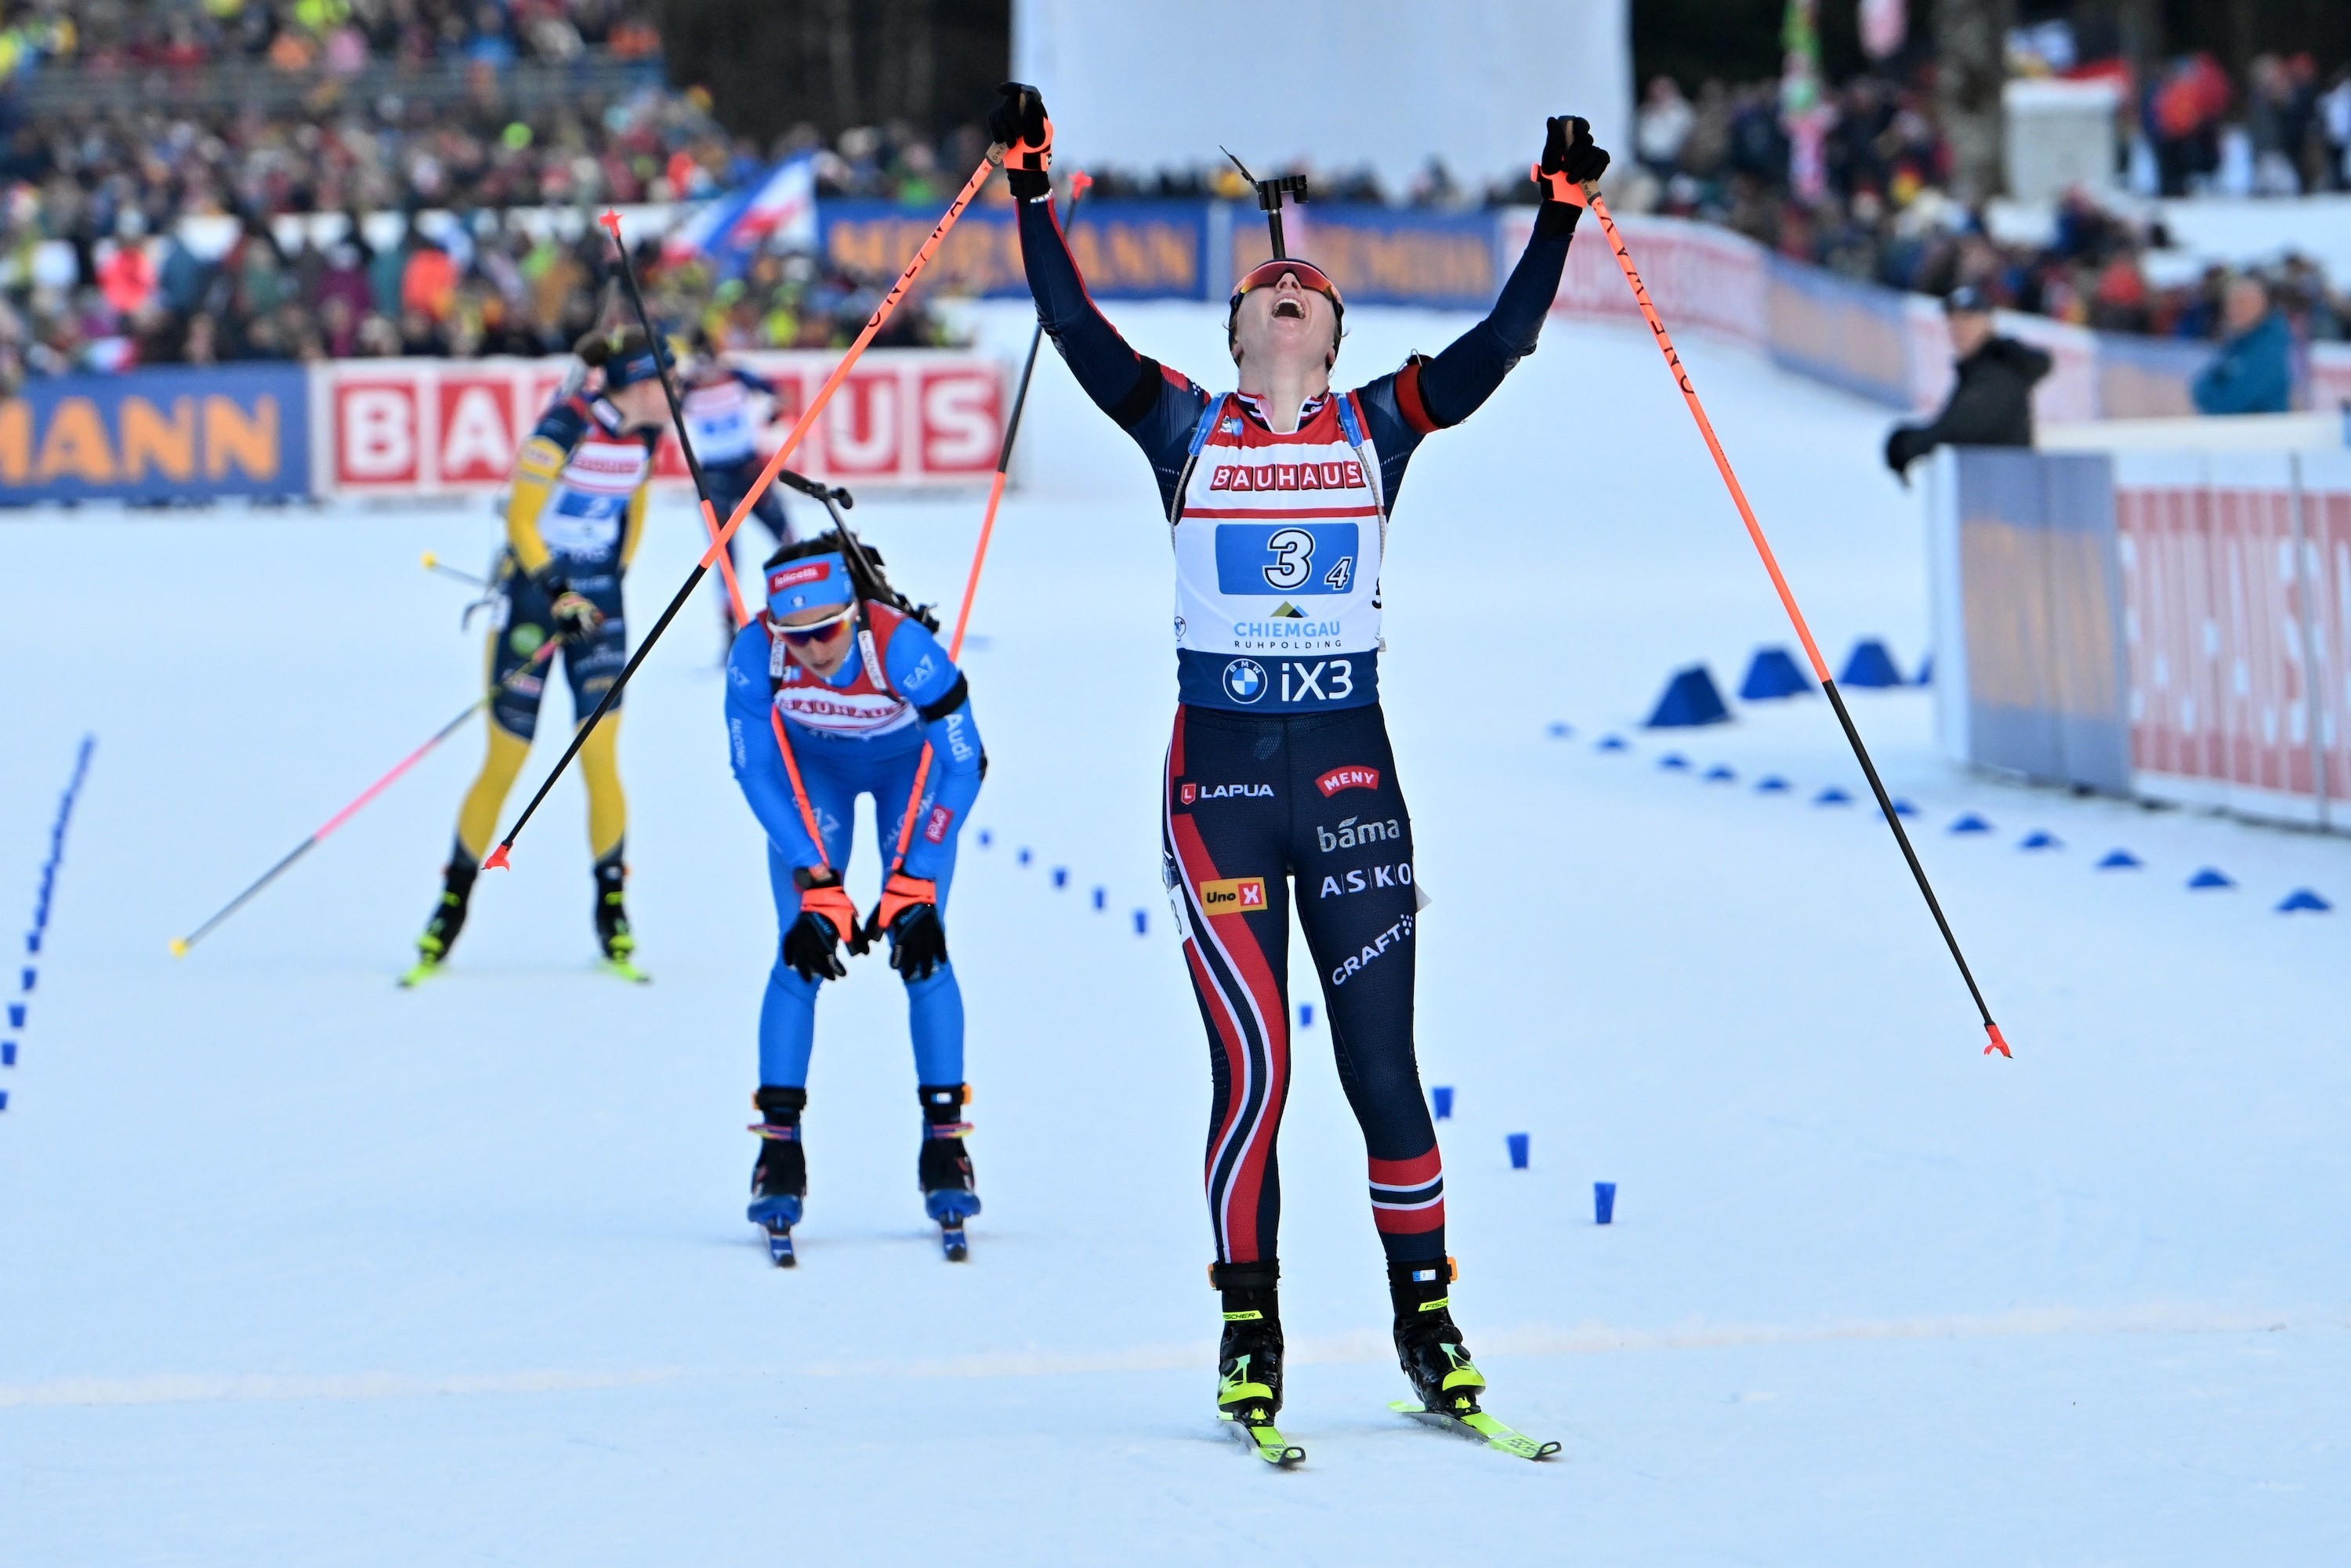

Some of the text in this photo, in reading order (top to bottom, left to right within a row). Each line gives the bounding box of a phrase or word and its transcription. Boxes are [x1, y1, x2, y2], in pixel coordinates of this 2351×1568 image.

[1213, 462, 1364, 488] BAUHAUS
[1262, 527, 1352, 590] 3 4
[1234, 621, 1341, 638] CHIEMGAU
[1234, 640, 1342, 650] RUHPOLDING
[1229, 661, 1260, 673] BMW
[1281, 660, 1353, 702] iX3
[944, 713, 974, 762] Audi
[1201, 784, 1274, 798] LAPUA
[1324, 771, 1375, 791] MENY
[1332, 922, 1401, 986] CRAFT
